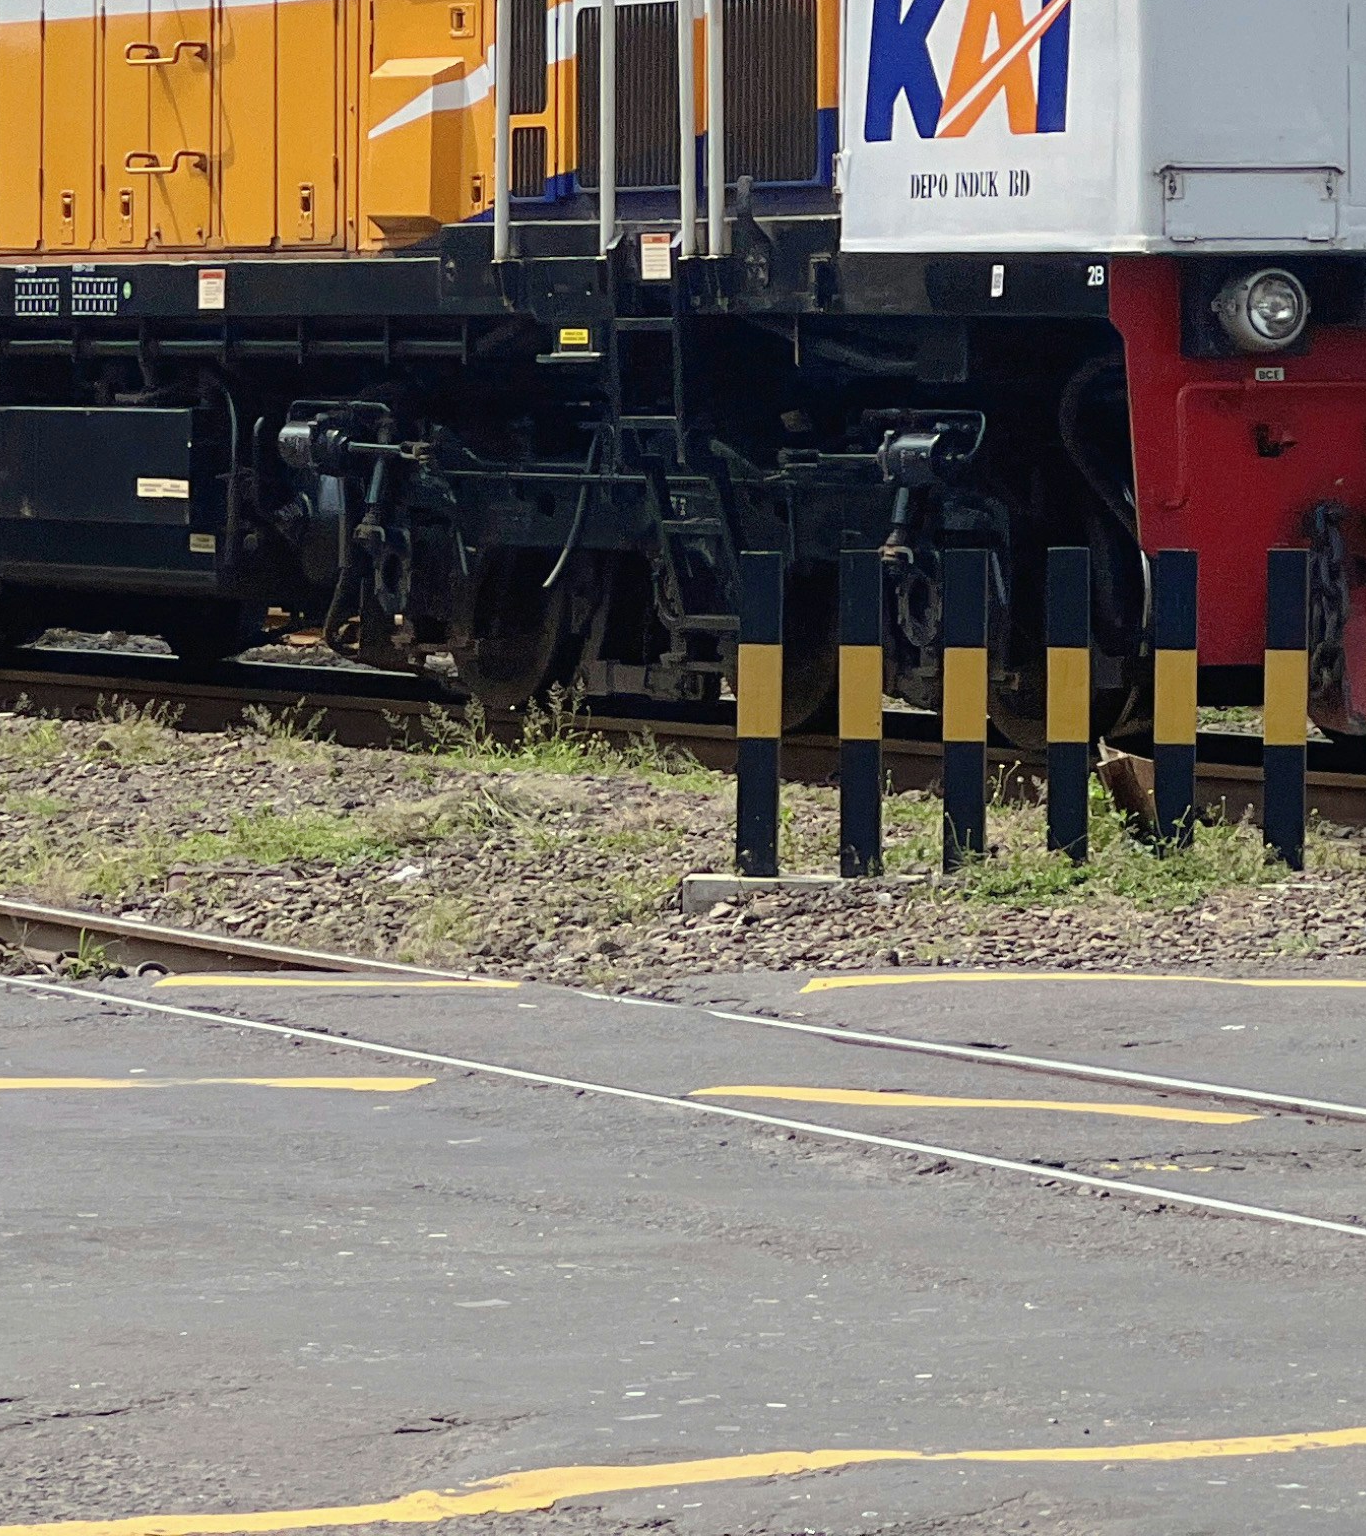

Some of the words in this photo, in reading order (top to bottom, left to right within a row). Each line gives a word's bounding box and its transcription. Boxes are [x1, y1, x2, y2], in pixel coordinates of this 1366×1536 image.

[910, 173, 948, 199] DEPO
[955, 171, 998, 198] INDUK
[1009, 169, 1030, 197] BD
[1087, 265, 1104, 286] 2B
